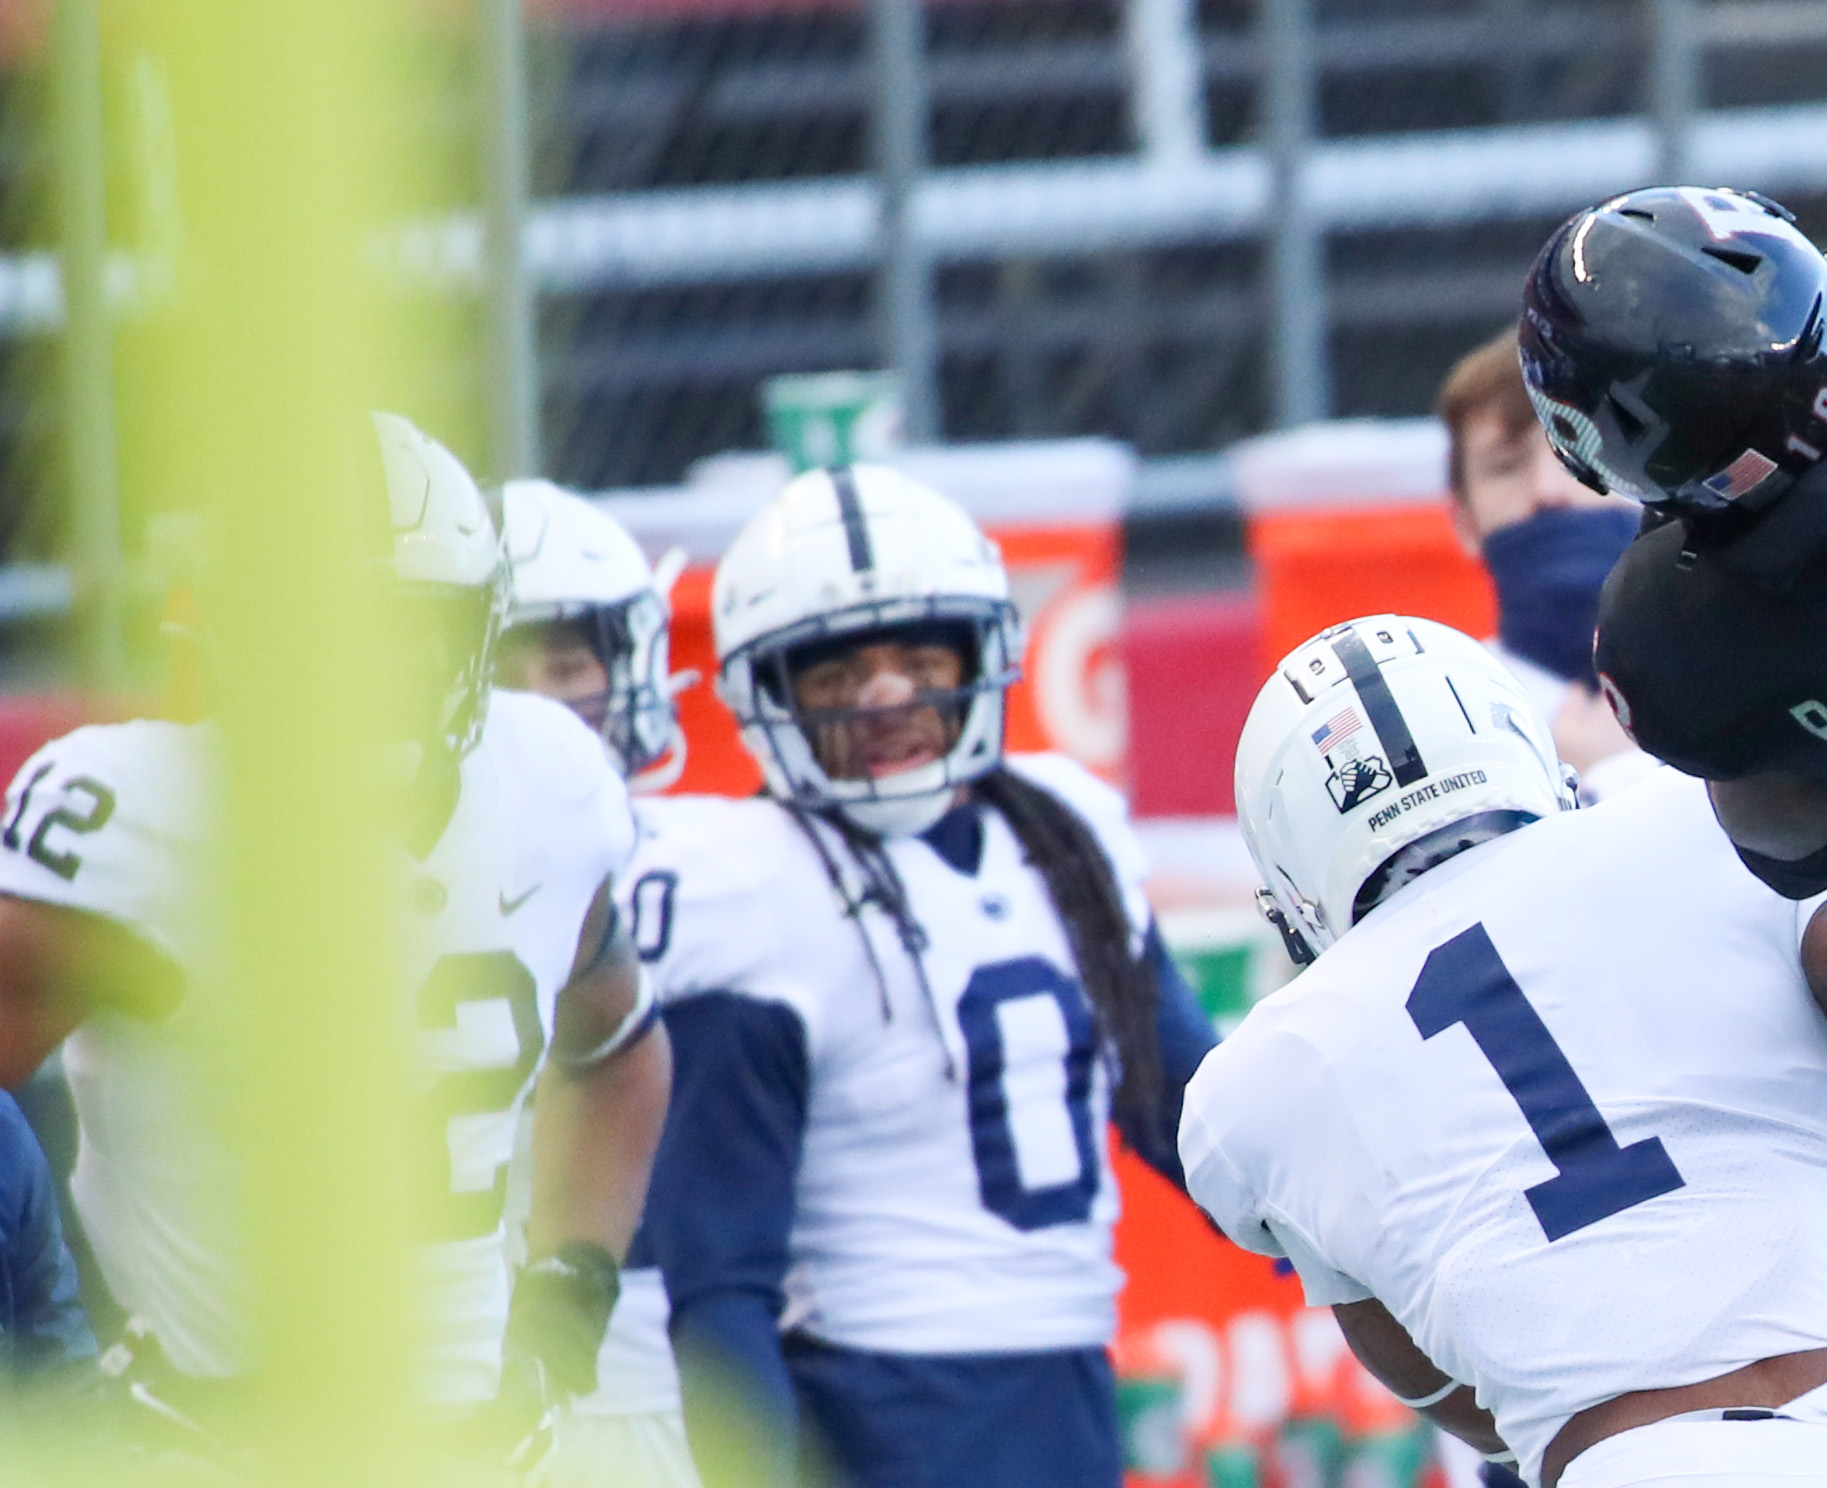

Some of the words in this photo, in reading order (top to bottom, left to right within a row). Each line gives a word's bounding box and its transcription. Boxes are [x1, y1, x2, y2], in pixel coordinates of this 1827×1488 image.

[2, 760, 118, 884] 12
[1368, 804, 1402, 832] PENN
[1400, 783, 1440, 811] STATE
[1440, 769, 1488, 794] UNITED
[631, 867, 681, 964] 0
[956, 954, 1101, 1234] 0
[1405, 921, 1687, 1243] 1
